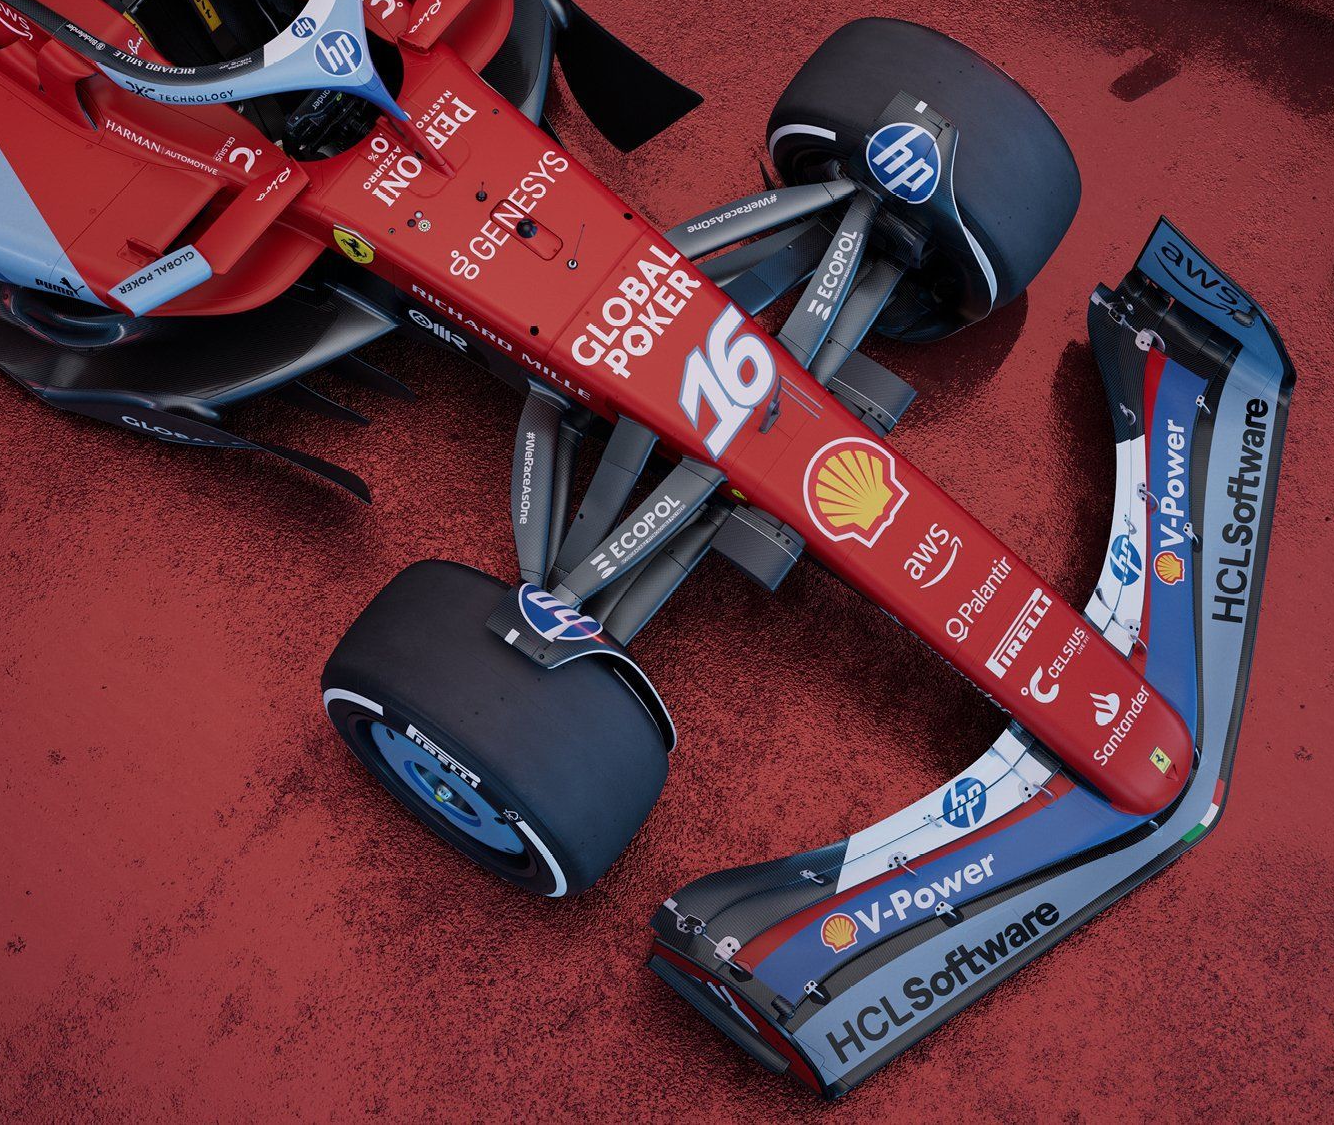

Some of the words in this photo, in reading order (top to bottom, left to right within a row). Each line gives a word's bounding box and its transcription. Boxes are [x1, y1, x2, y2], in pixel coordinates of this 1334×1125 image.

[66, 23, 97, 46] Bitdefender
[409, 0, 441, 34] Riva
[113, 50, 144, 67] MILLE
[146, 63, 196, 75] RICHARD
[316, 30, 361, 76] hp
[125, 80, 156, 101] DXC
[158, 90, 234, 103] TECHNOLOGY
[416, 90, 452, 129] NASTRO
[106, 119, 162, 155] HARMAN
[165, 149, 218, 176] AUTOMOTIVE
[216, 136, 235, 162] CELSIUS
[363, 145, 402, 190] AZZURRO
[371, 97, 477, 207] PERONI
[870, 123, 940, 203] hp
[255, 166, 292, 201] Riva
[469, 150, 568, 262] GENESYS
[686, 193, 778, 233] #WeRaceAsOne
[118, 275, 152, 294] POKER
[152, 251, 195, 279] GLOBAL
[823, 230, 858, 302] ECOPOL
[1161, 241, 1242, 306] aws
[570, 245, 680, 367] GLOBAL
[605, 269, 701, 380] POKER
[412, 283, 512, 351] RICHARD
[522, 352, 593, 402] MILLE
[678, 302, 777, 461] 16
[519, 431, 536, 525] #WeRaceAsOne
[1160, 419, 1185, 548] V-Power
[610, 495, 682, 559] ECOPOL
[1213, 398, 1269, 624] HCLSoftware
[904, 523, 951, 581] aws
[1110, 535, 1142, 586] hp
[958, 556, 1012, 624] Palantir
[985, 587, 1053, 679] PIRELLI
[1048, 627, 1087, 679] CELSIUS
[1076, 642, 1085, 655] LIVE
[1094, 684, 1149, 766] Santander
[406, 724, 482, 790] PIRELLI
[944, 777, 987, 828] hp
[855, 853, 995, 934] V-Power
[826, 902, 1059, 1064] HCLSoftware
